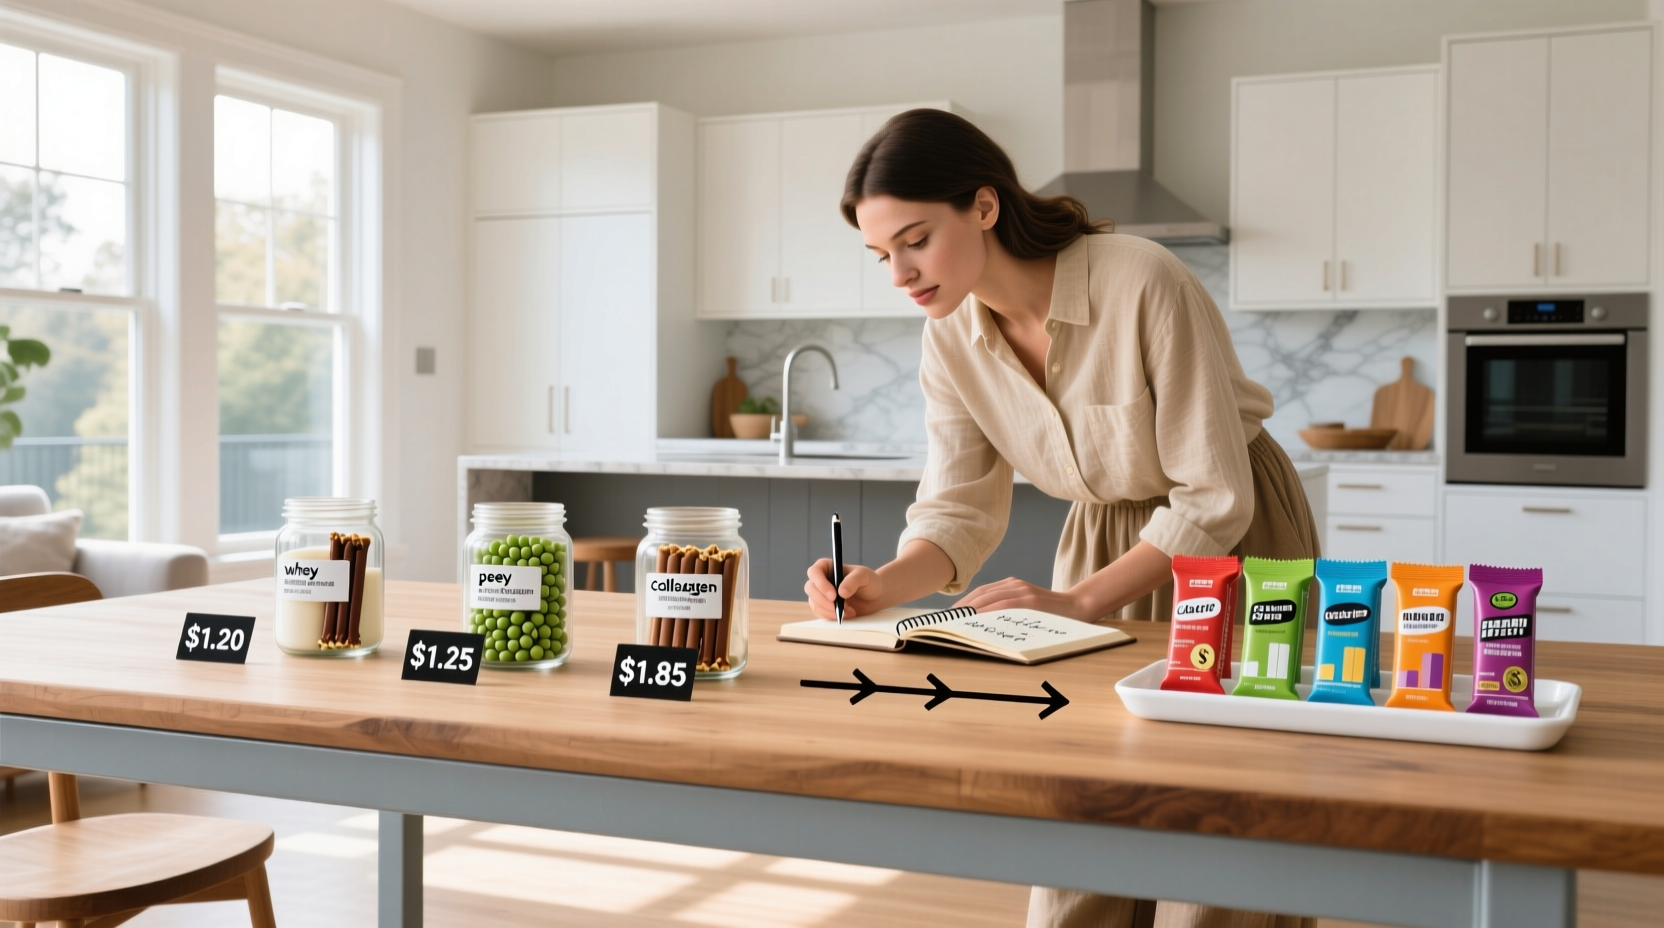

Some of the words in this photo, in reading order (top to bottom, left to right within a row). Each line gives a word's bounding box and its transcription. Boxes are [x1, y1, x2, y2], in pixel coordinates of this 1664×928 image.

[284, 562, 319, 580] whey
[478, 572, 512, 586] peey
[185, 623, 245, 653] $1.20
[410, 640, 475, 671] $1.25
[618, 655, 687, 687] $1.85
